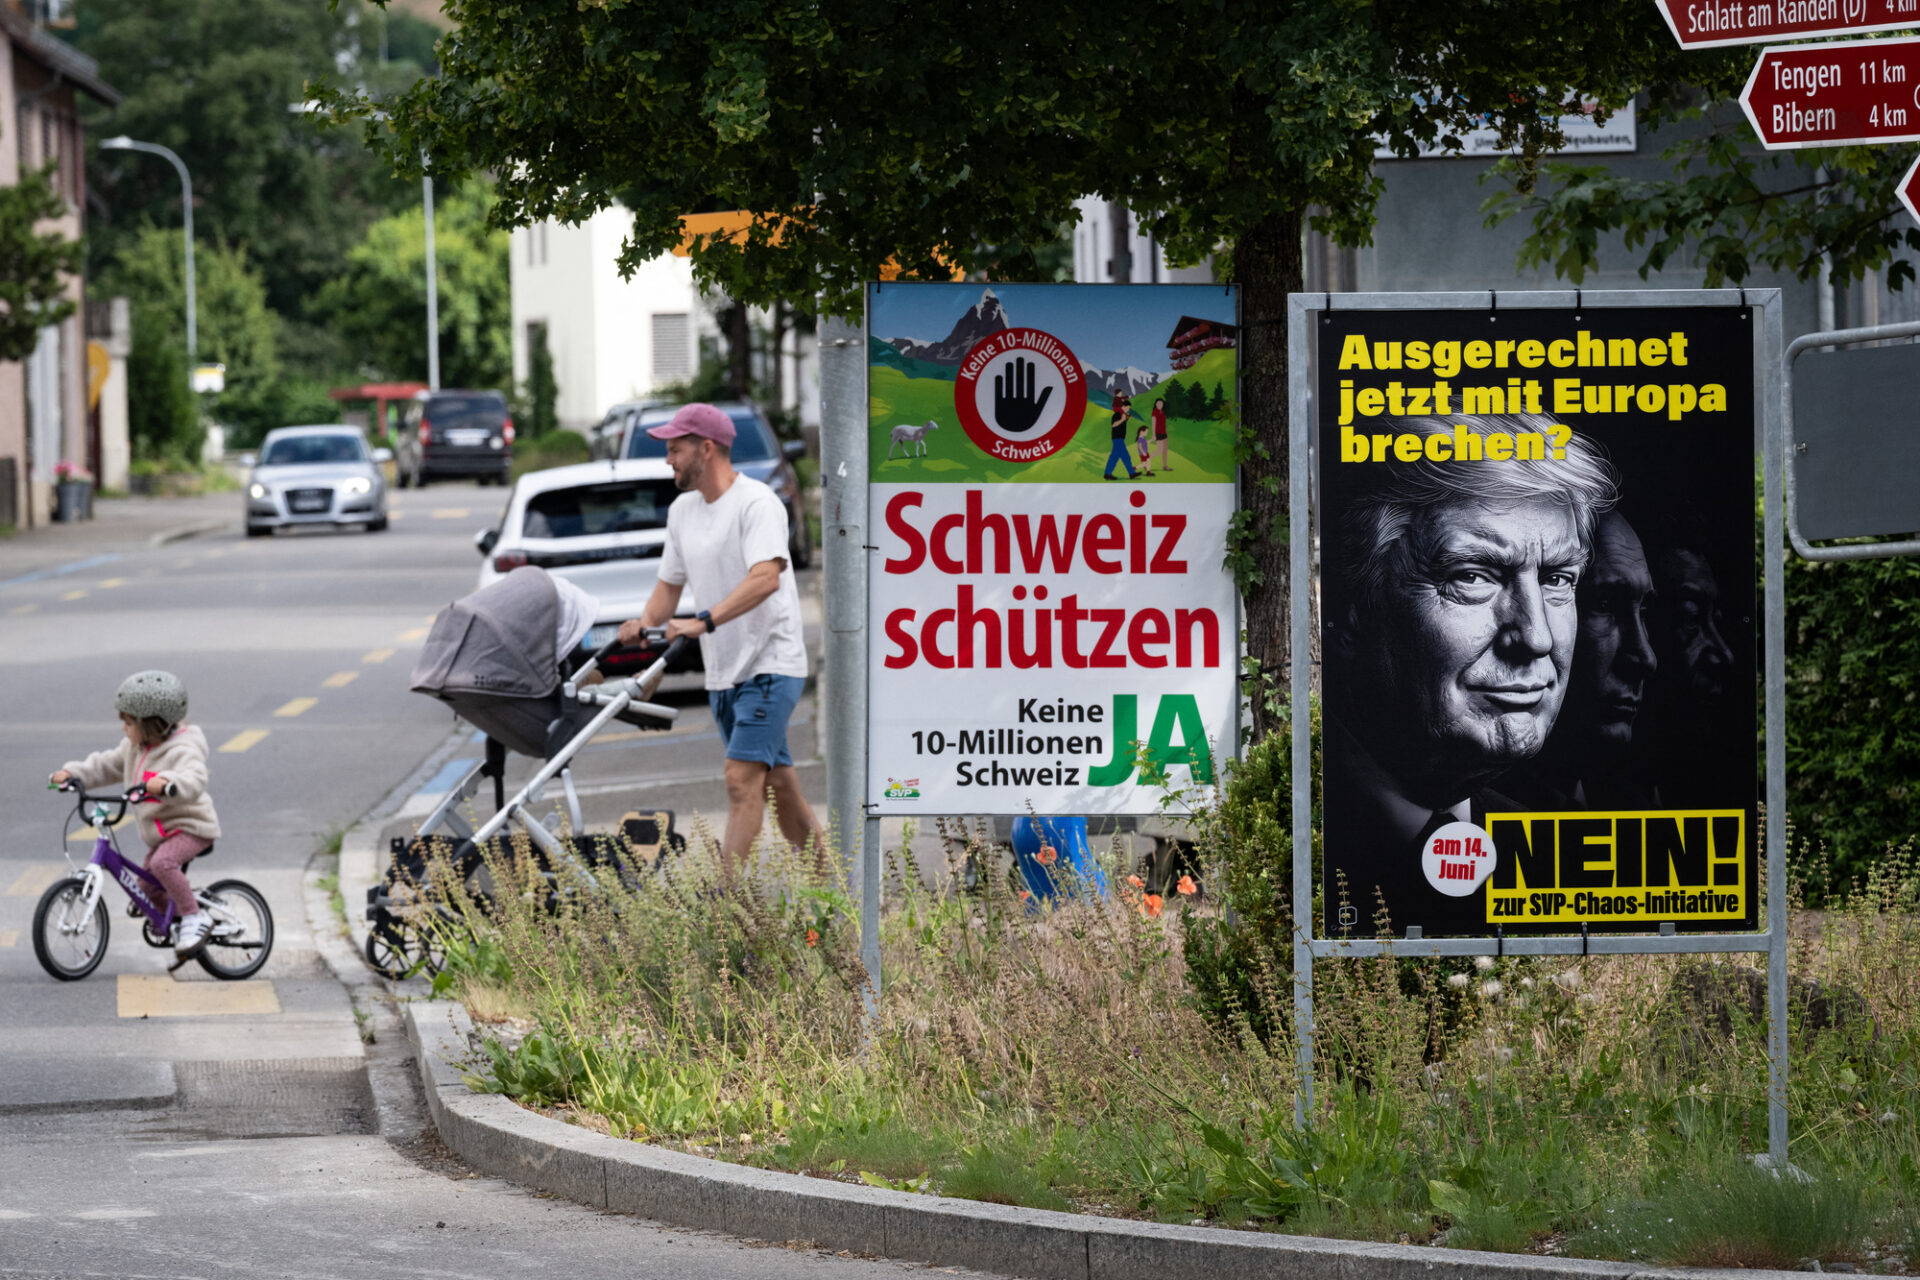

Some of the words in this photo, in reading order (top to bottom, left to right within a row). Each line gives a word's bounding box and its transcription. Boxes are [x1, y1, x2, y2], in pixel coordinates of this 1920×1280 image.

[1688, 0, 1743, 33] Schlatt
[1748, 4, 1772, 27] am
[1777, 0, 1837, 24] Randen
[1843, 0, 1867, 24] (D)
[1771, 61, 1841, 96] Tengen
[1859, 61, 1876, 85] 11
[1883, 59, 1906, 83] km
[1772, 101, 1836, 134] Bibern
[1869, 104, 1879, 128] 4
[1883, 102, 1907, 127] km
[960, 343, 998, 381] Keine
[996, 331, 1079, 384] 10-Millionen
[1338, 331, 1689, 378] Ausgerechnet
[1338, 380, 1453, 425] jetzt
[1462, 377, 1544, 415] mit
[1553, 378, 1728, 421] Europa
[991, 440, 1055, 460] Schweiz
[1340, 424, 1573, 463] brechen?
[884, 489, 1188, 575] Schweiz
[884, 584, 1220, 670] schützen
[1018, 697, 1104, 724] Keine
[911, 728, 1103, 755] 10-Millionen
[1087, 693, 1215, 788] JA
[956, 760, 1080, 787] Schweiz
[890, 788, 913, 798] SVP
[1432, 839, 1461, 856] am
[1464, 837, 1488, 857] 14.
[1491, 815, 1740, 889] NEIN!
[1438, 859, 1476, 881] Juni
[1492, 897, 1526, 916] zur
[1529, 890, 1739, 916] SVP-Chaos-Initiative
